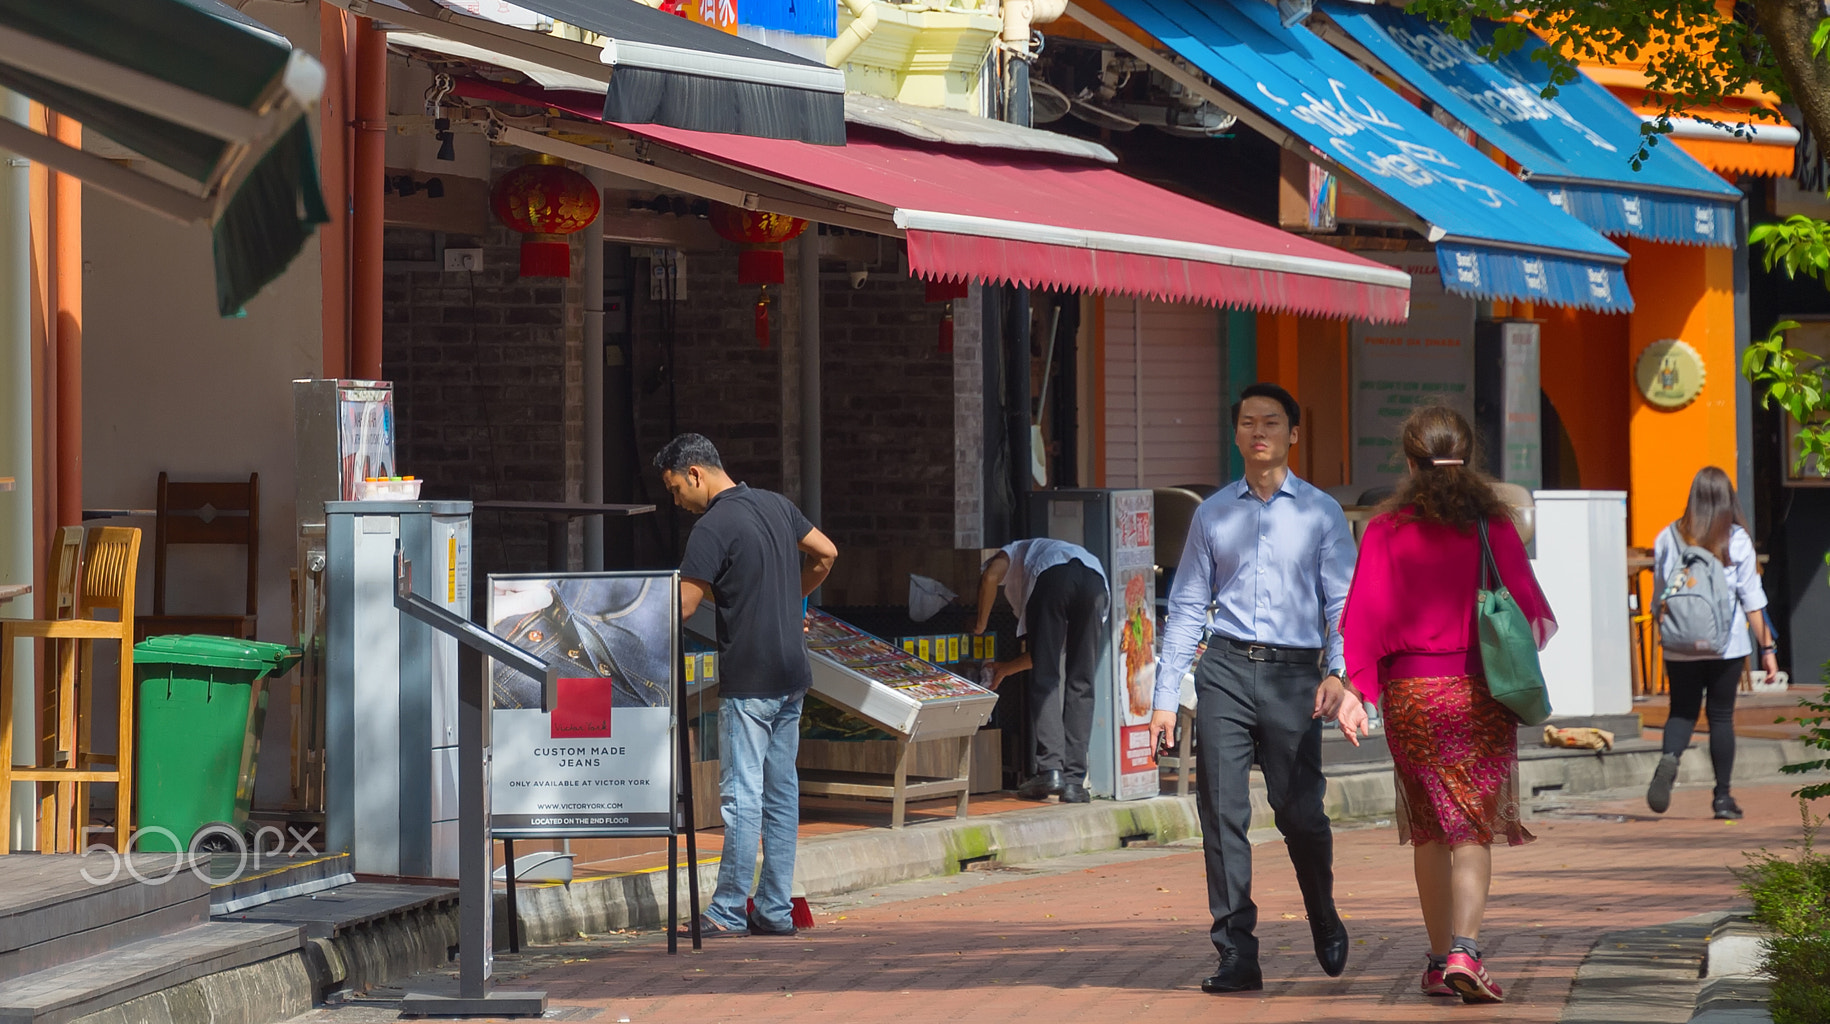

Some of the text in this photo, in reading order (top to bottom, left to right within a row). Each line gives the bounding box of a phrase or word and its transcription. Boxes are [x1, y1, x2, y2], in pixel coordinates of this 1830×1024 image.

[534, 747, 626, 756] CUSTOM MADE
[559, 758, 601, 767] JEANS
[537, 802, 623, 810] WWW.VICTORYORK.COM
[576, 817, 589, 825] THE
